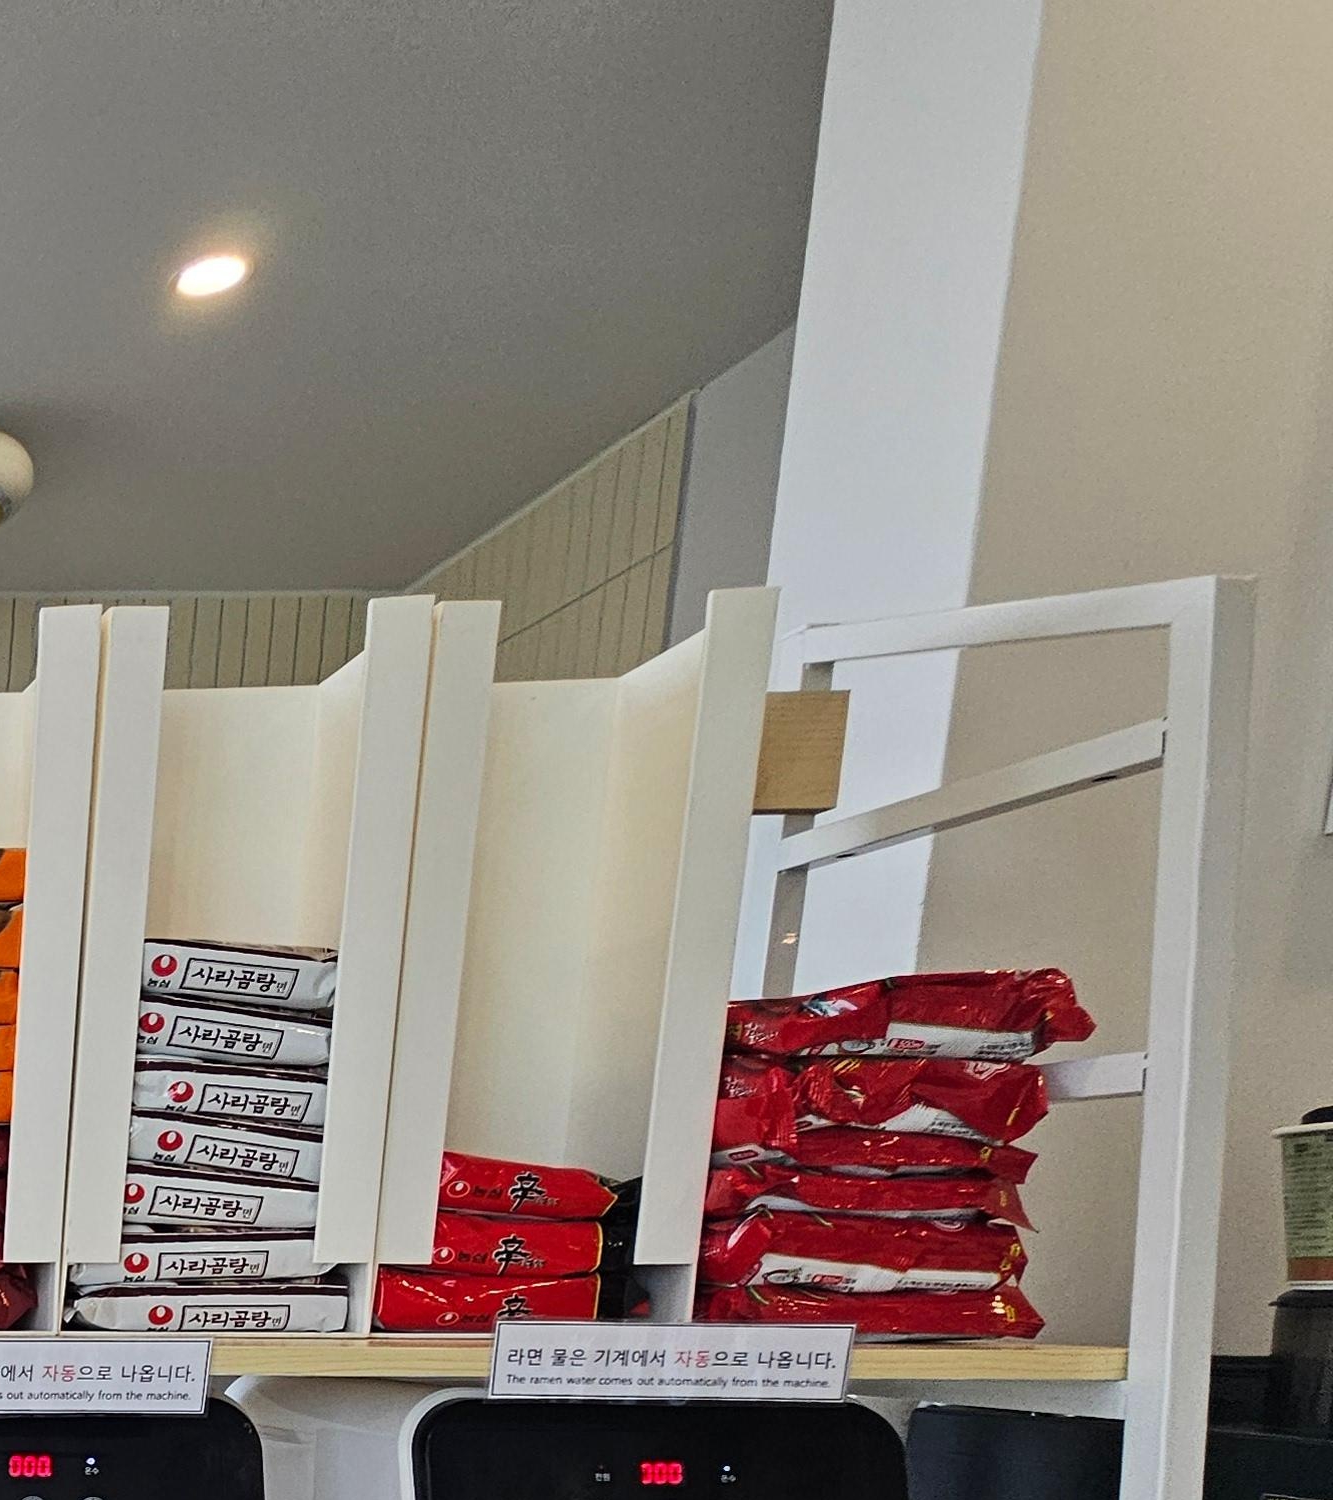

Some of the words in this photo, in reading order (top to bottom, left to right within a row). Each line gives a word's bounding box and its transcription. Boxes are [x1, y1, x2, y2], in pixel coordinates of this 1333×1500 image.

[508, 1171, 547, 1212] 辛
[492, 1233, 532, 1276] 辛
[507, 1348, 542, 1367] 라면
[551, 1349, 587, 1368] 물은
[594, 1349, 666, 1368] 기계에서
[675, 1349, 749, 1368] 자동으로
[757, 1351, 836, 1370] 나옵니다.
[42, 1364, 112, 1383] 자동으로
[122, 1365, 196, 1384] 나옵니다.
[506, 1374, 526, 1385] The
[530, 1376, 563, 1386] ramen
[566, 1376, 597, 1386] water
[599, 1377, 633, 1386] comes
[636, 1376, 655, 1386] out
[658, 1375, 728, 1390] automatically
[731, 1376, 758, 1388] from
[762, 1376, 780, 1388] the
[784, 1377, 831, 1389] machine.
[6, 1390, 24, 1400] out
[27, 1389, 95, 1402] automatically
[98, 1389, 123, 1400] from
[126, 1390, 143, 1400] the
[146, 1390, 191, 1401] machine.
